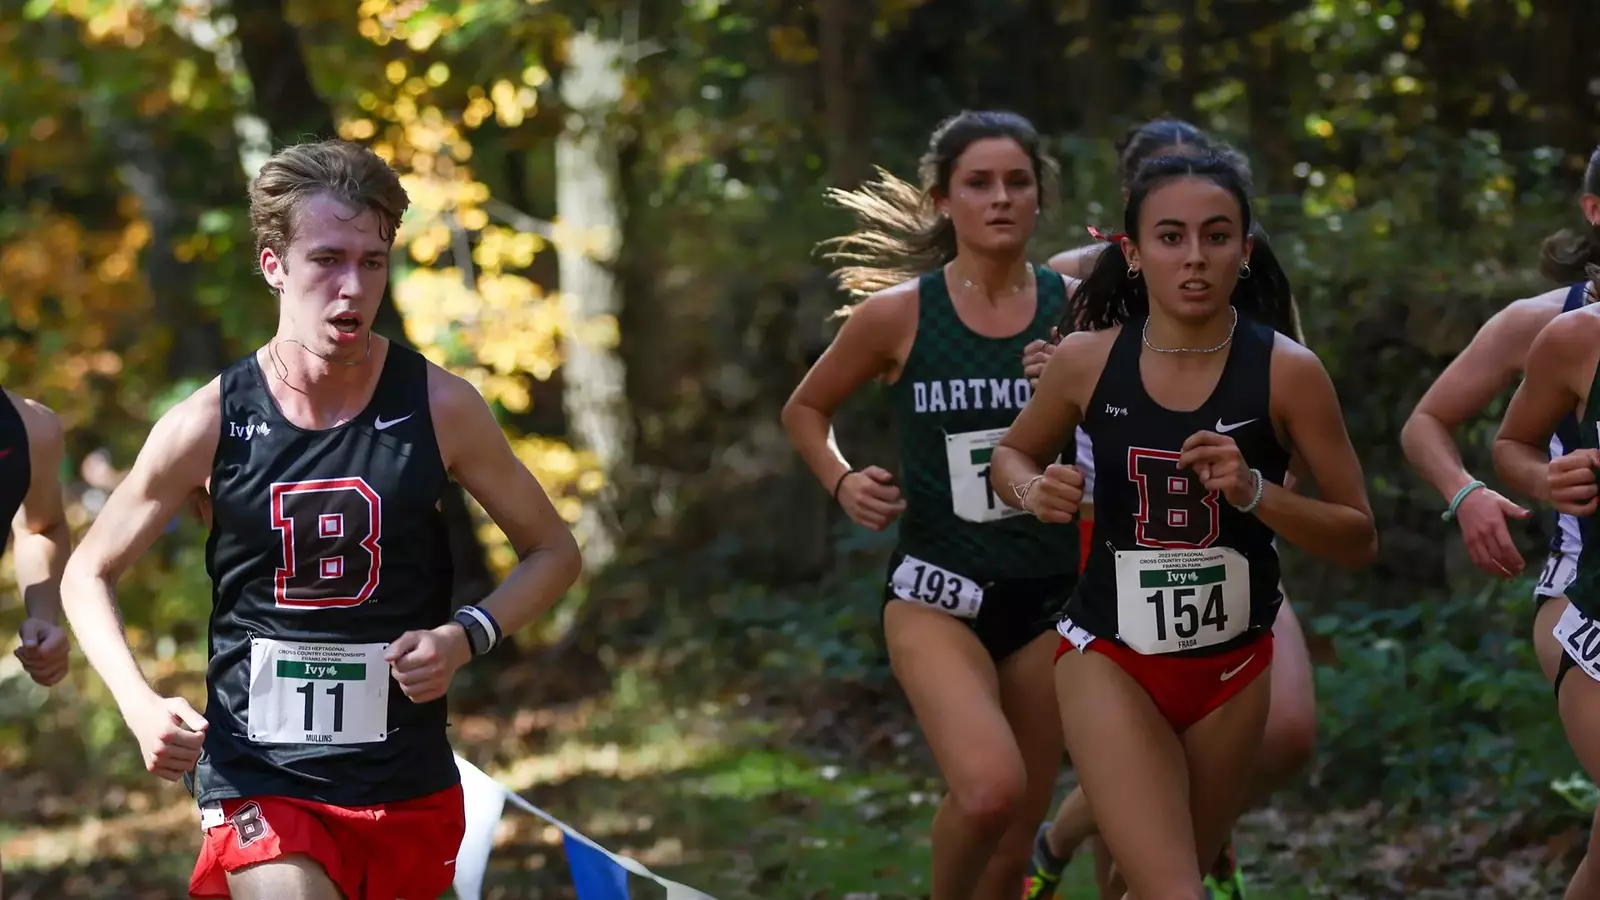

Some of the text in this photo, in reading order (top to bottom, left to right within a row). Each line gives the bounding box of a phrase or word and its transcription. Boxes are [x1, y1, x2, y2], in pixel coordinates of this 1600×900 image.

[1105, 403, 1121, 417] Ivy
[229, 421, 255, 440] Ivy
[1127, 446, 1219, 549] B
[270, 476, 381, 609] B
[1181, 554, 1224, 563] CHAMPIONSHIPS
[909, 565, 962, 610] 193
[1166, 571, 1187, 584] Ivy
[1146, 584, 1228, 641] 154
[304, 664, 326, 678] Ivy
[296, 682, 344, 732] 11
[305, 733, 332, 743] MULLINS
[228, 800, 269, 849] B
